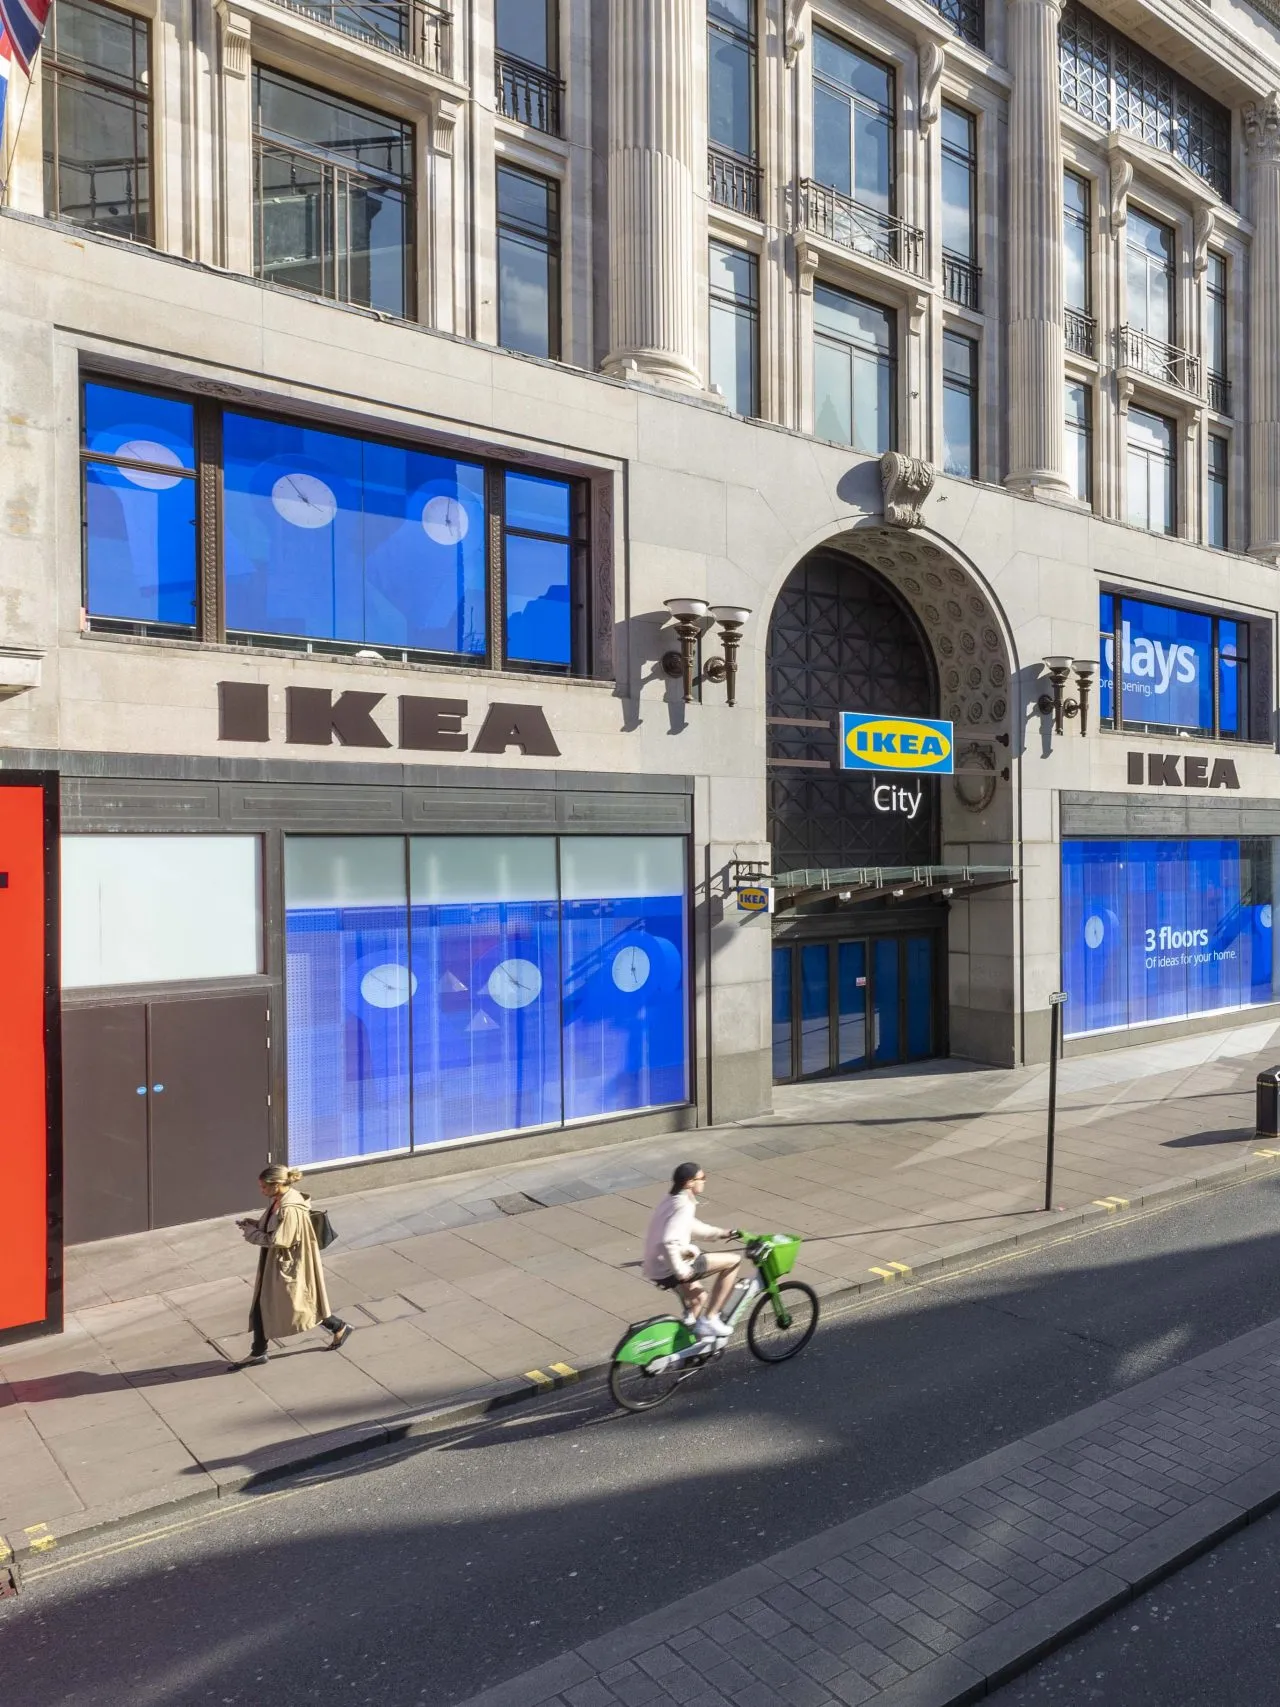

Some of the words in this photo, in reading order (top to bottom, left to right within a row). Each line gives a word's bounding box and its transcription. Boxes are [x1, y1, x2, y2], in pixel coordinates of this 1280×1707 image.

[1104, 620, 1196, 694] days
[217, 680, 562, 757] IKEA
[856, 731, 944, 756] IKEA
[1127, 751, 1241, 789] IKEA
[873, 785, 922, 819] City
[740, 893, 766, 904] IKEA
[1144, 928, 1156, 952] 3
[1159, 926, 1209, 950] floors
[1145, 957, 1157, 969] Of
[1158, 955, 1180, 967] ideas
[1180, 953, 1193, 965] for
[1193, 953, 1212, 966] your
[1213, 949, 1238, 961] home.
